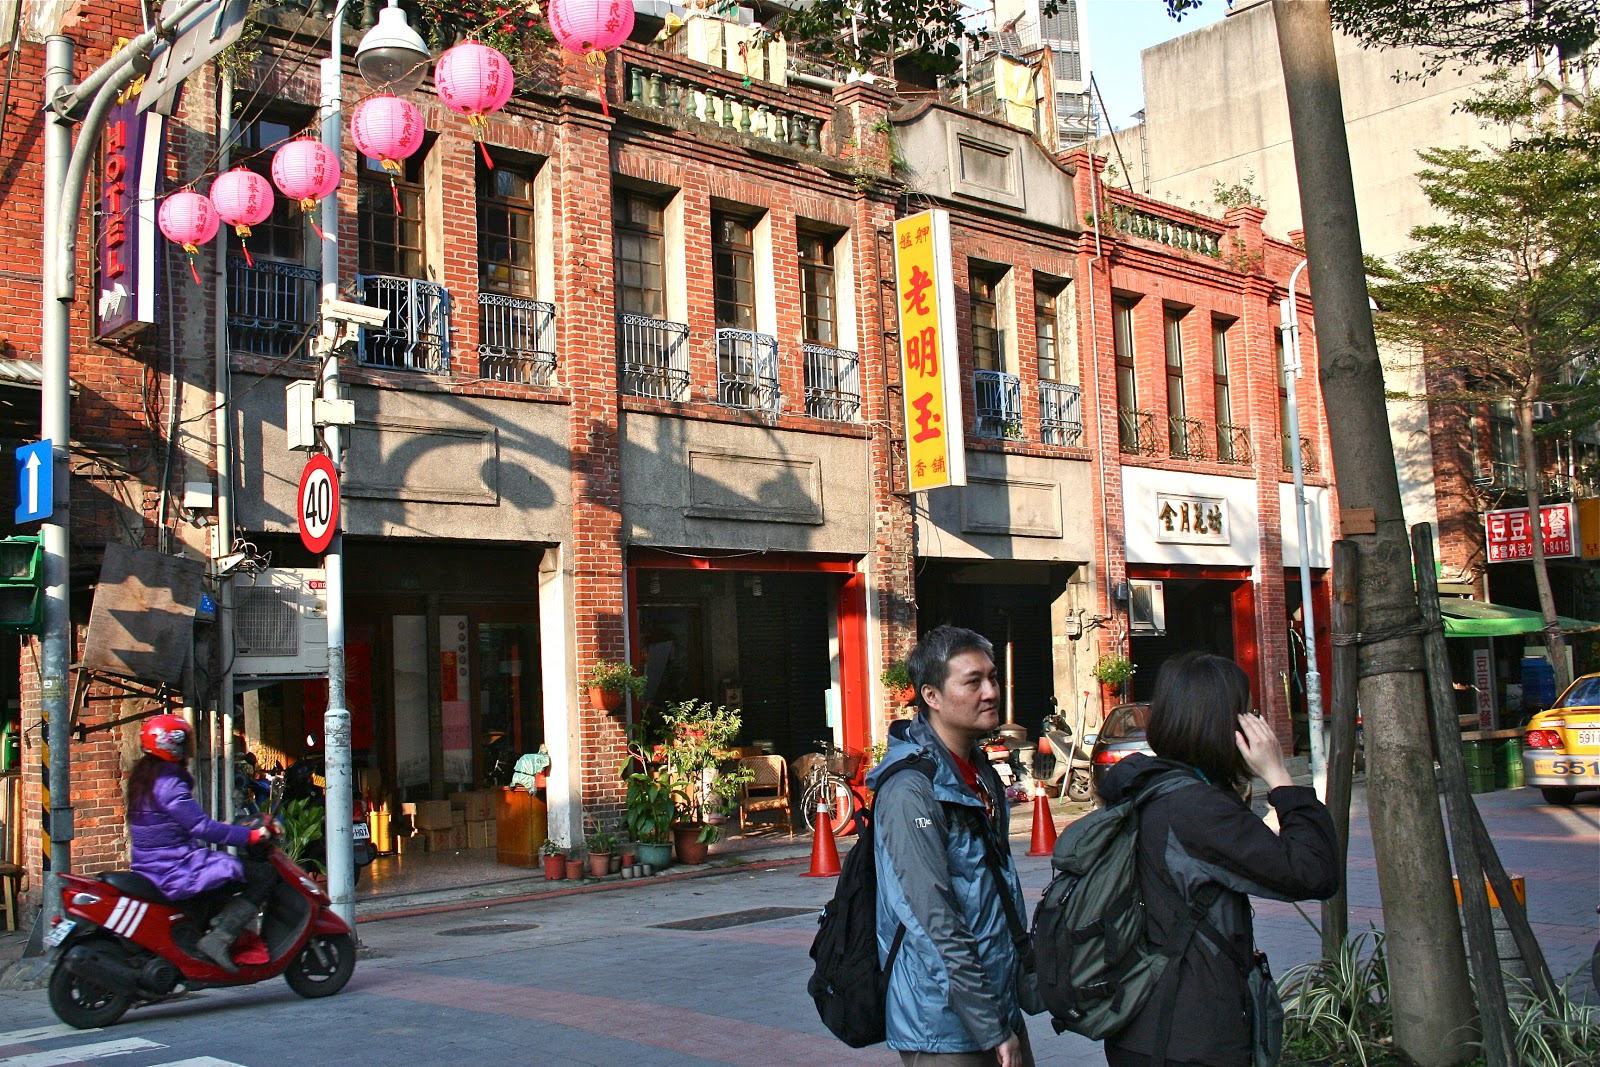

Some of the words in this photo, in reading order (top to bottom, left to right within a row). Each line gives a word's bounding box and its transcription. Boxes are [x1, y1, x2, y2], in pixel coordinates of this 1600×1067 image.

[105, 119, 126, 279] HOTEL
[899, 226, 930, 250] 艋舺
[904, 265, 941, 443] 老明玉
[305, 478, 330, 528] 40
[1476, 656, 1492, 727] 豆豆快餐
